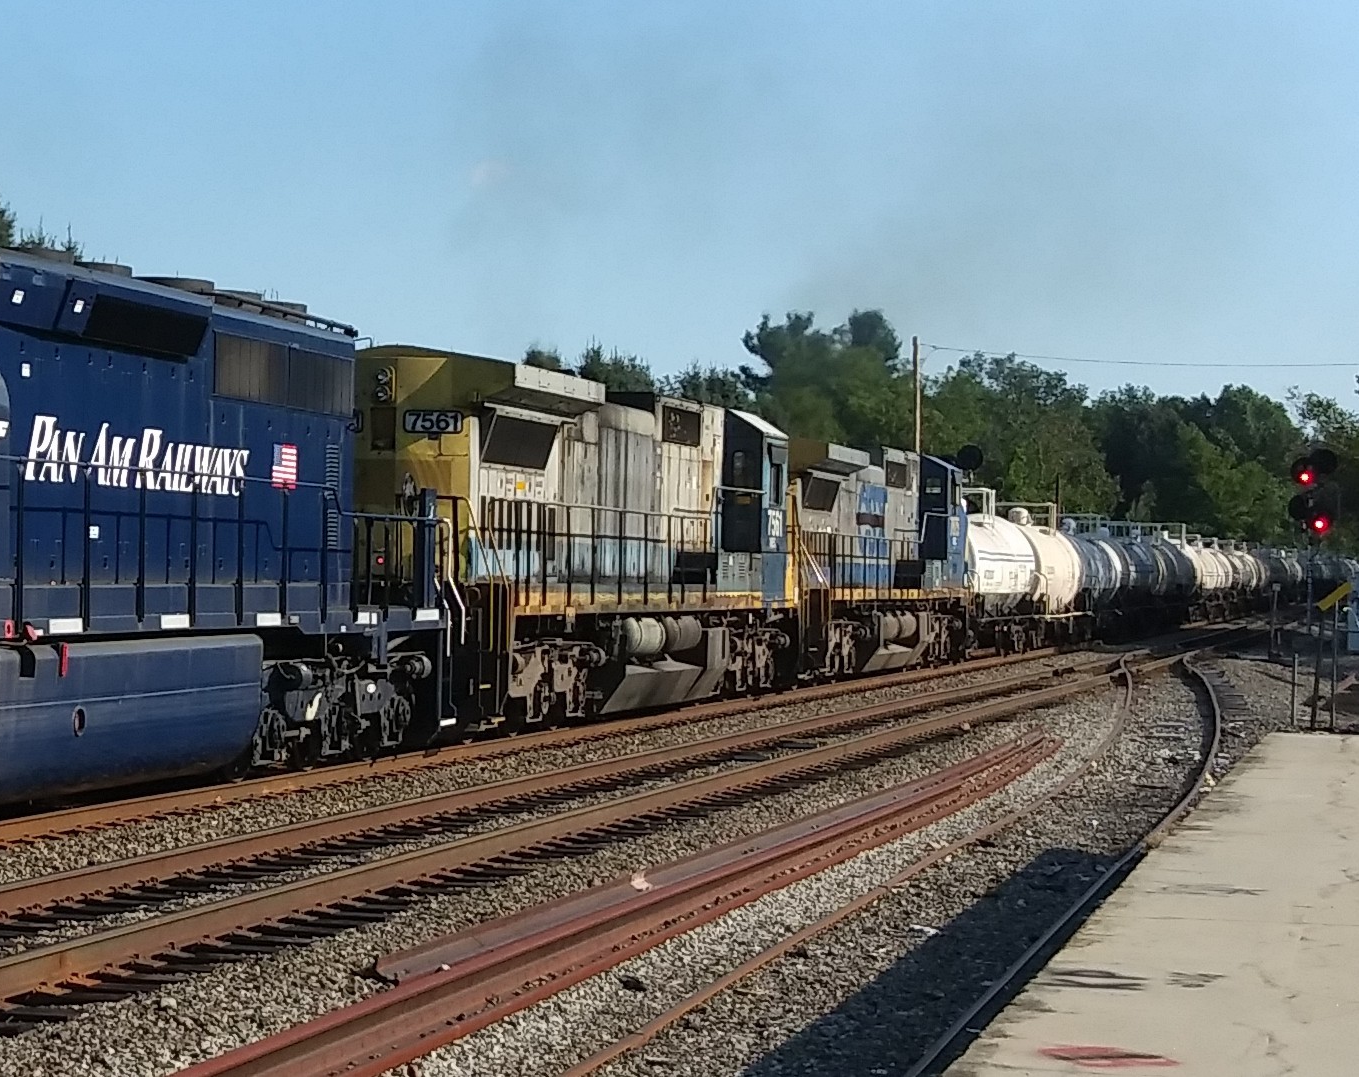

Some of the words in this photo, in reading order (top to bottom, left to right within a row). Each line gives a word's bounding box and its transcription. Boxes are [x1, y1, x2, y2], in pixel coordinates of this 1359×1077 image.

[408, 412, 459, 431] 7561
[24, 414, 86, 484] PAN
[90, 422, 137, 489] AM
[135, 428, 250, 497] RAILWAYS
